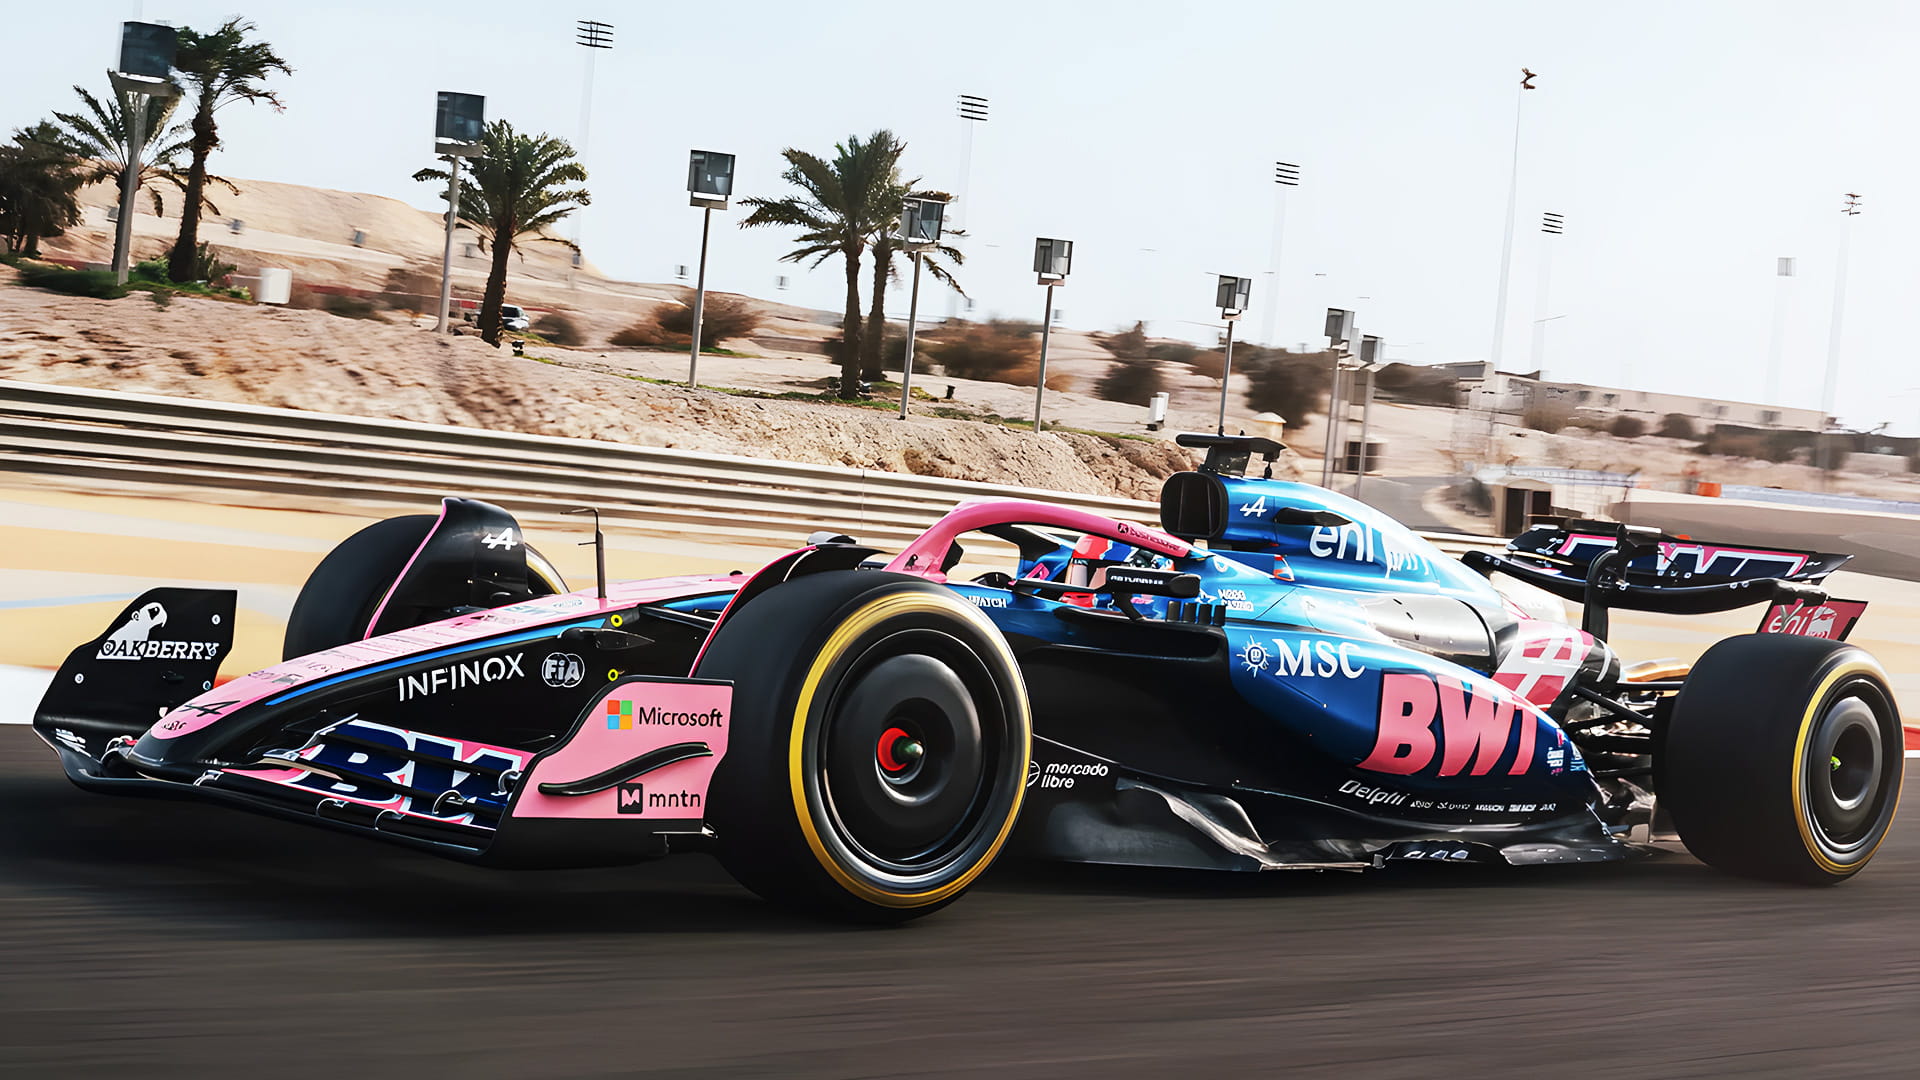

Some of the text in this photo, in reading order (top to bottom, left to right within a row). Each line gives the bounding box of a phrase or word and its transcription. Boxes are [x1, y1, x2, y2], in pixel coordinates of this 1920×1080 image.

[98, 640, 220, 660] OAKBERRY
[1272, 638, 1366, 679] MSC
[399, 652, 525, 702] INFINOX
[638, 706, 723, 728] Microsoft
[1356, 673, 1538, 778] BWT
[1040, 775, 1075, 789] libre
[649, 789, 701, 808] mntn
